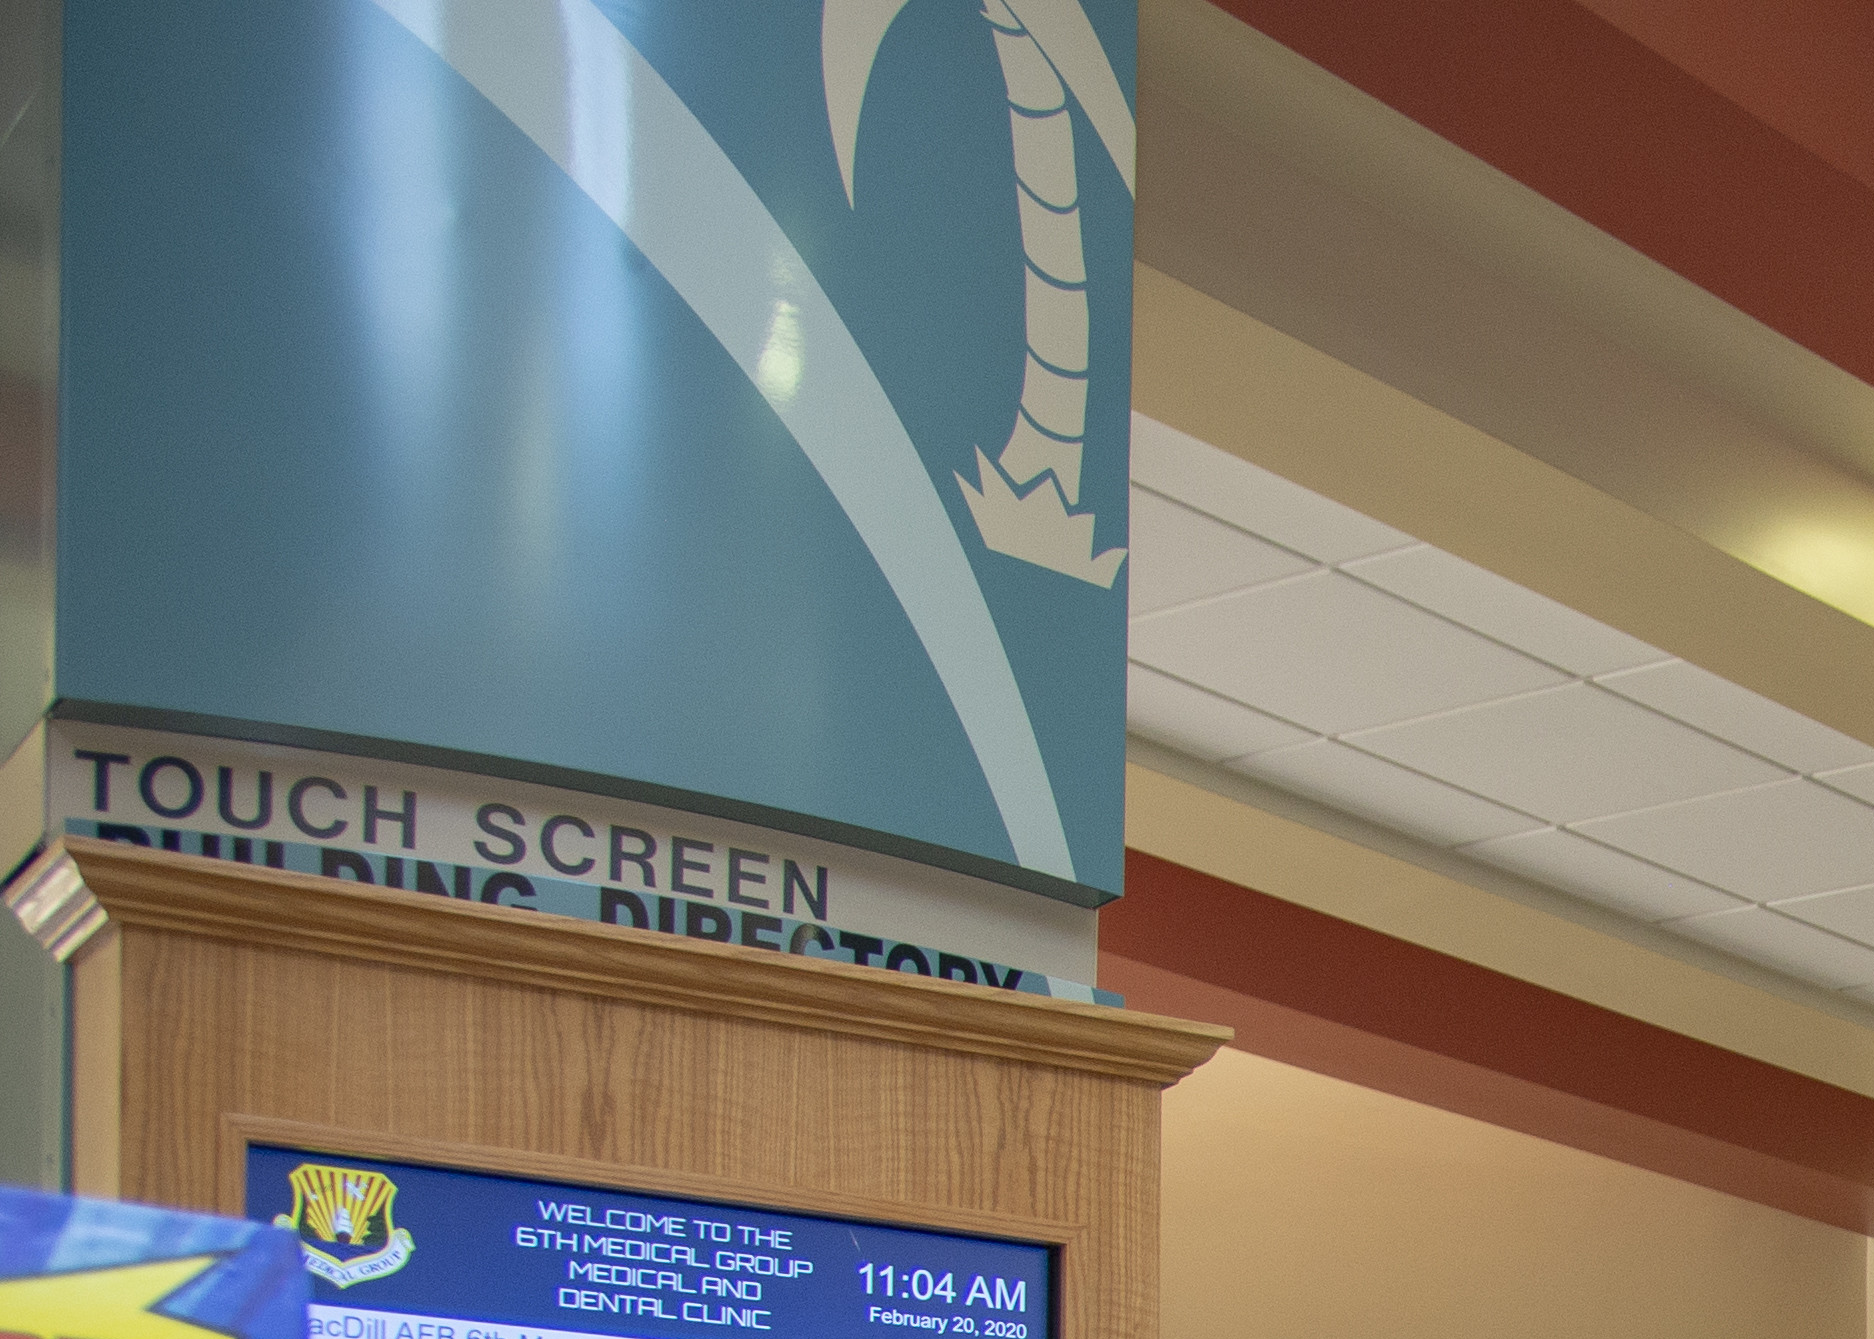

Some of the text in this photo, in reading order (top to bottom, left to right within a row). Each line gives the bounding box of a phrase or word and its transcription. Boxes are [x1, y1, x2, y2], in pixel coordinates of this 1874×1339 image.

[74, 748, 831, 922] TOUCH SCREEN
[538, 1200, 793, 1251] WELCOME TO THE
[515, 1226, 814, 1279] 6TH MEDICAL GROUP
[569, 1260, 762, 1302] MEDICAL AND
[858, 1262, 1027, 1313] 11:04 AM
[558, 1287, 772, 1330] DENTAL CLINIC
[869, 1305, 1028, 1339] February 20, 2020
